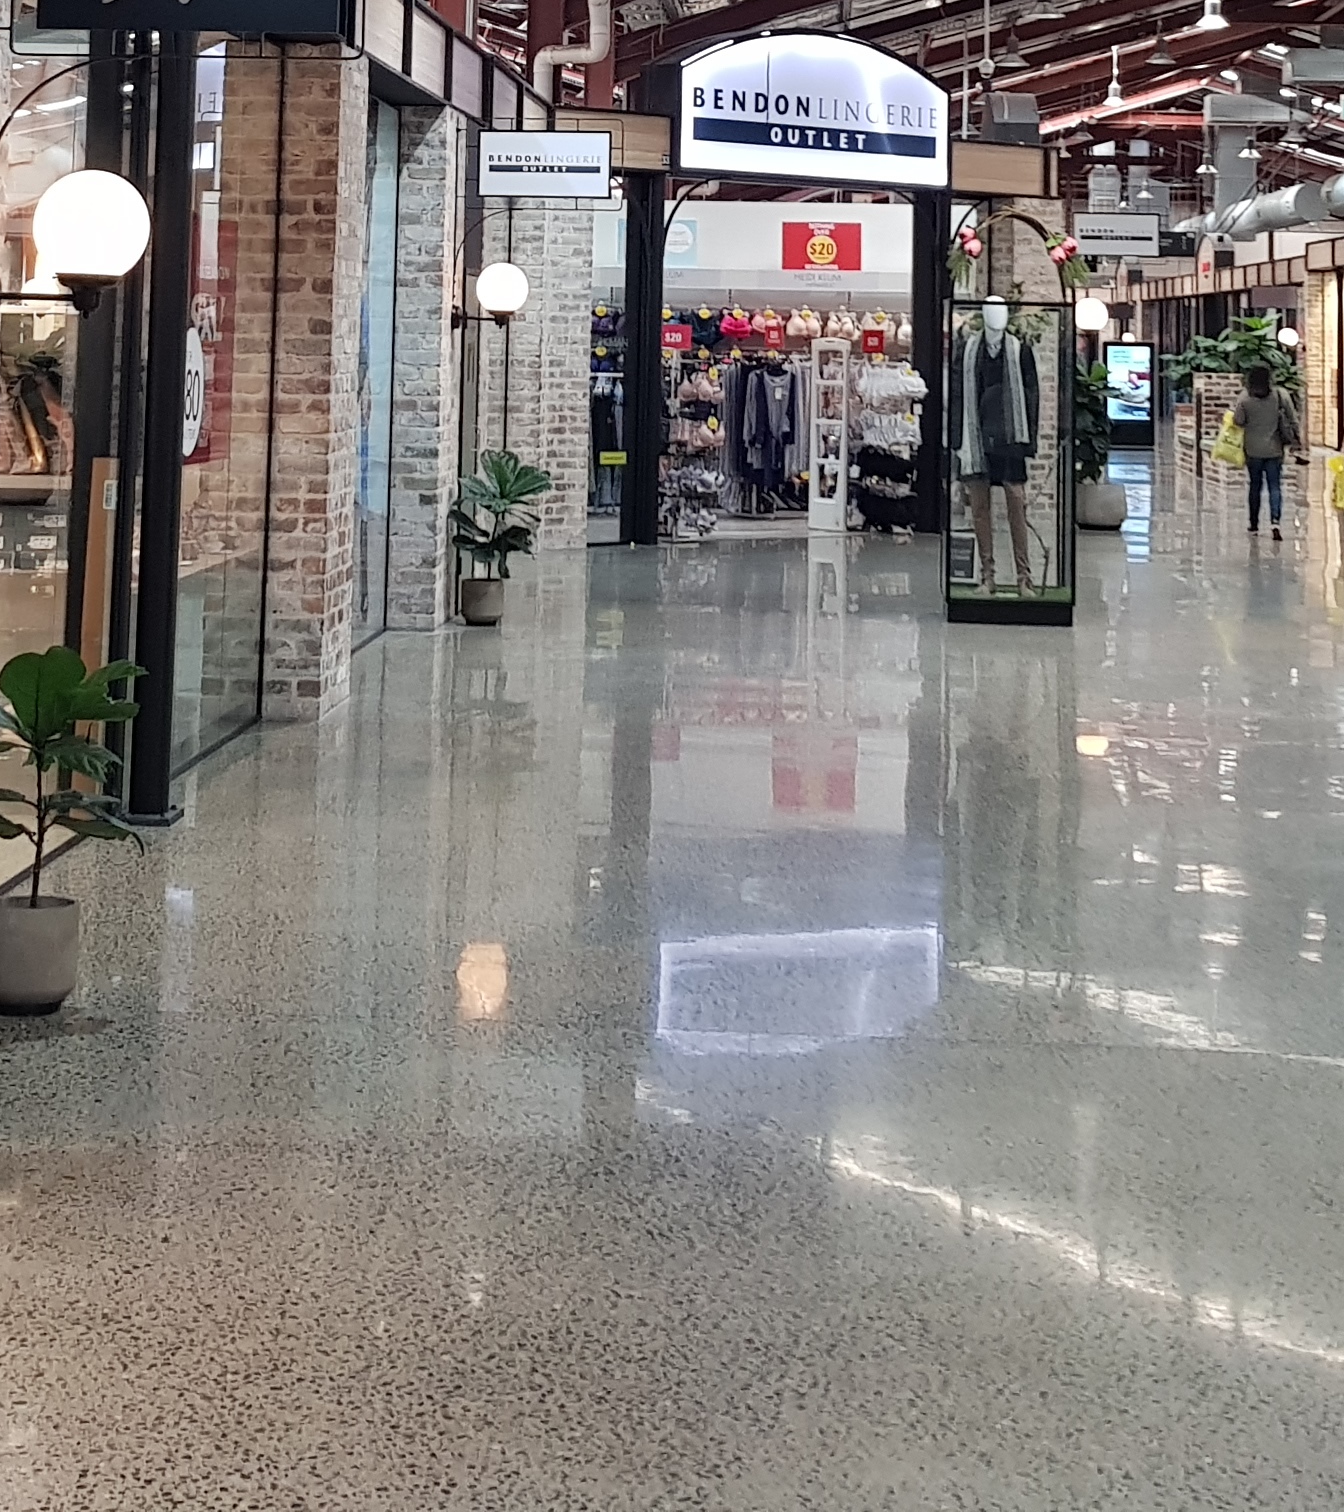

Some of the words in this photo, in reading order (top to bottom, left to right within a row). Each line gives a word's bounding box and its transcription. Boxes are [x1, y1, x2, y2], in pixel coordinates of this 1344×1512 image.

[769, 126, 867, 151] OUTLET
[522, 165, 569, 173] OUTLET
[809, 242, 834, 256] $20
